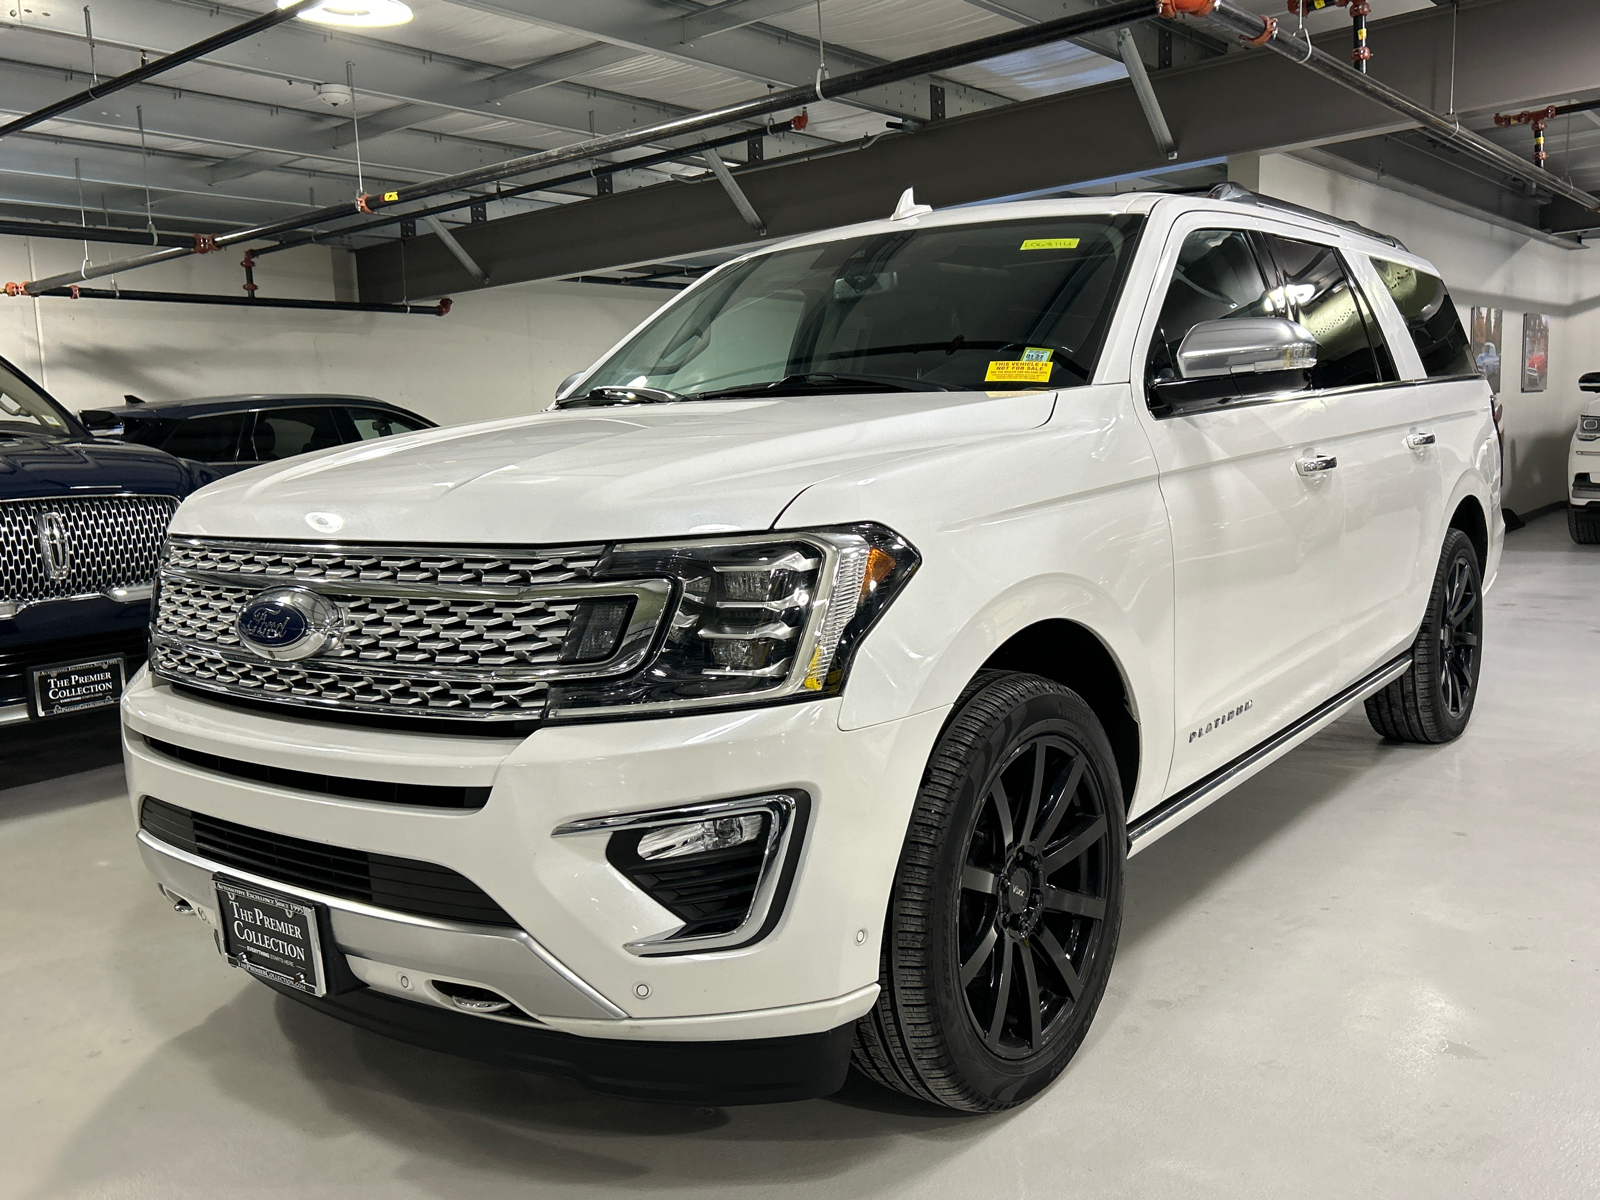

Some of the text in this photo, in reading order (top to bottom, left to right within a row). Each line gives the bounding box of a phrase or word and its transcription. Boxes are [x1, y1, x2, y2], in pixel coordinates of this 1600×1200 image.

[247, 607, 290, 638] Ford
[48, 672, 112, 689] THE PREMIER
[48, 682, 113, 700] COLLECTION
[1189, 699, 1252, 743] PLATINUM
[230, 901, 303, 940] THE PREMIER
[234, 920, 305, 961] COLLECTION
